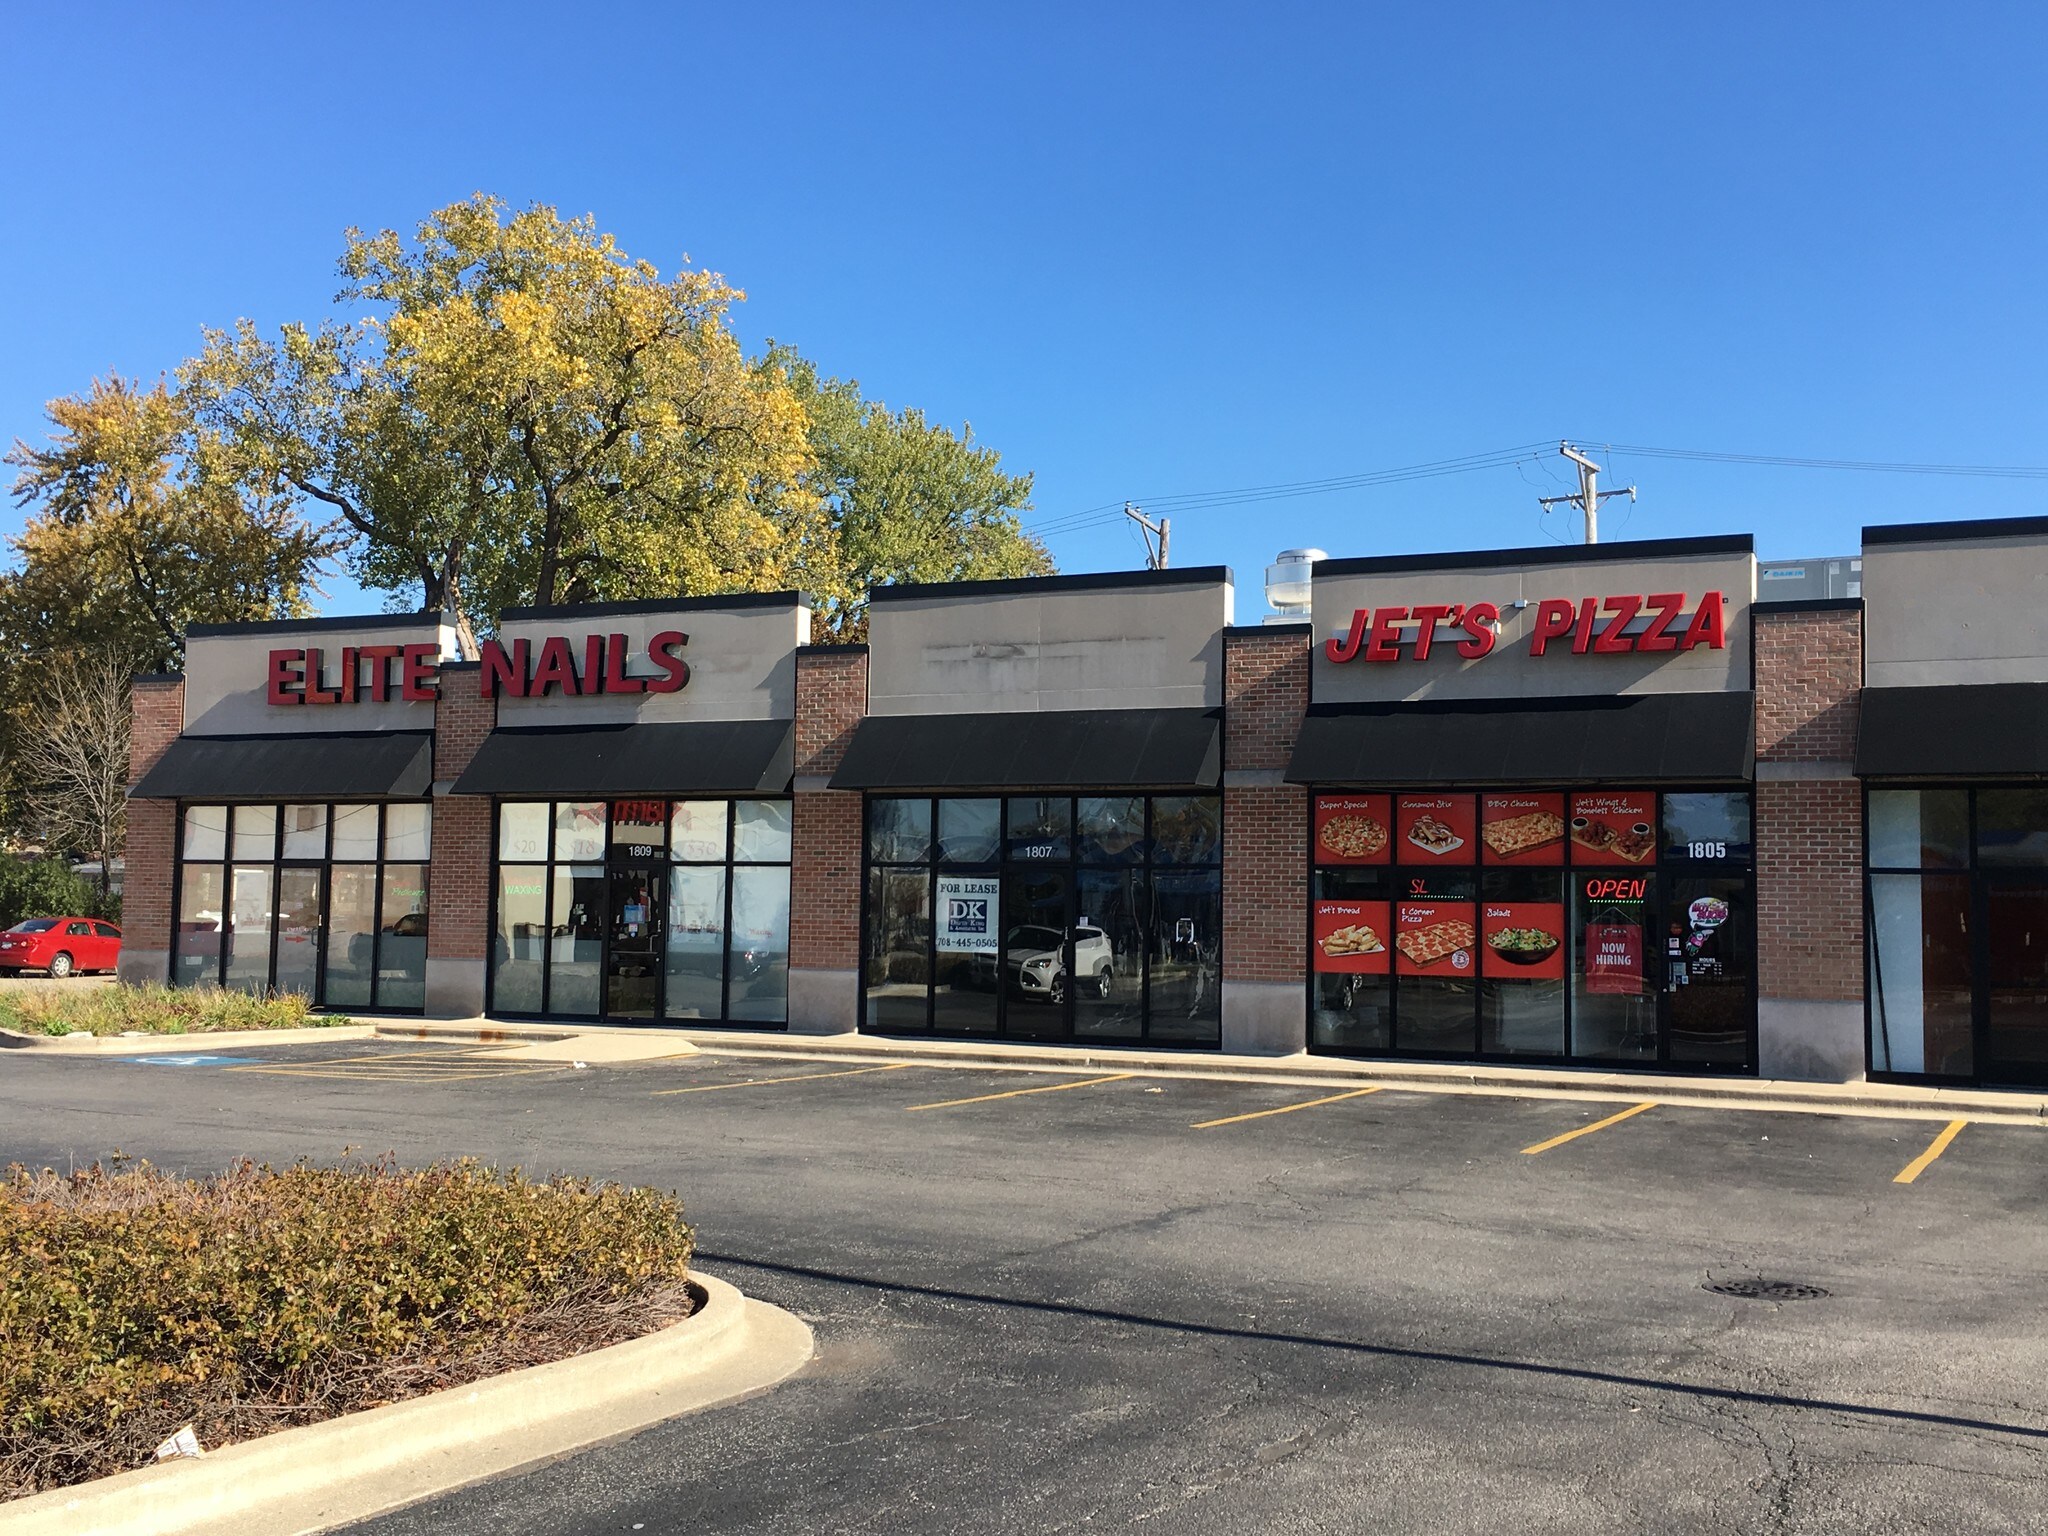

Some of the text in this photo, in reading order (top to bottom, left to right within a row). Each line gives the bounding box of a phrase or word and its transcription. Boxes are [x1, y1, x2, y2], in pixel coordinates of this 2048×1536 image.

[1326, 591, 1726, 664] JET'S PIZZA
[267, 630, 690, 705] ELITE NAILS
[1319, 800, 1368, 810] Super Special
[1402, 801, 1434, 809] Cinnamon
[1487, 800, 1539, 808] BBQ Chicken
[1596, 799, 1619, 809] Wings
[1576, 806, 1643, 815] Boneless Chicken
[629, 846, 652, 857] 1809
[1025, 846, 1052, 858] 1807
[1687, 842, 1726, 858] 1805
[505, 885, 542, 895] WAXING
[940, 883, 997, 894] FOR LEASE
[1587, 879, 1646, 898] OPEN
[949, 901, 985, 919] DK
[1408, 908, 1434, 916] Corner
[1402, 915, 1422, 923] Pizza
[937, 938, 997, 948] 708-445-0505
[1602, 943, 1625, 953] NOW
[1596, 954, 1632, 966] HIRING
